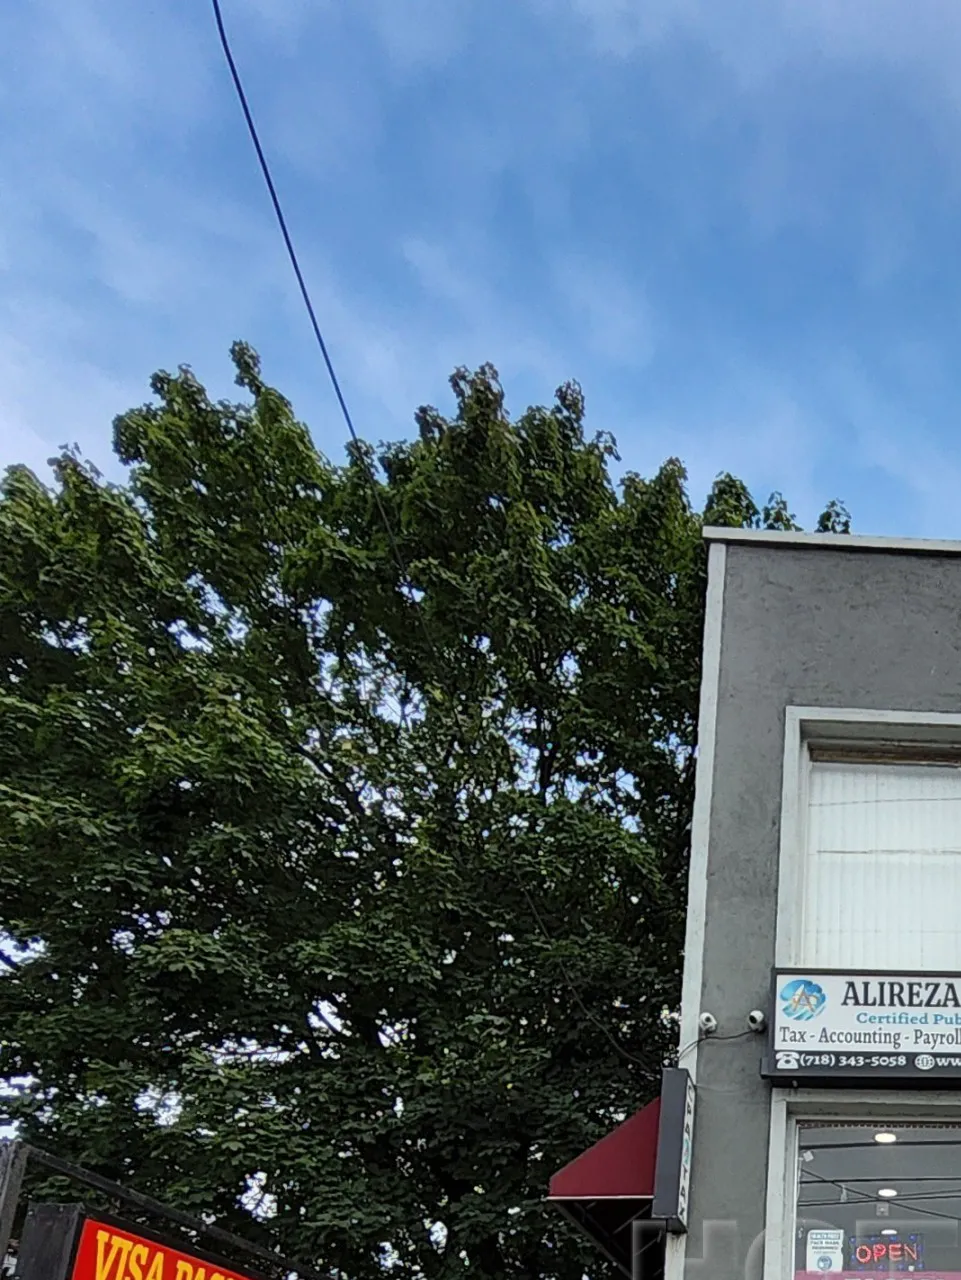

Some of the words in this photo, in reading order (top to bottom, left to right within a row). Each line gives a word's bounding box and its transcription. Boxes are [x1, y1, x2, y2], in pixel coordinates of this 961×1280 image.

[841, 981, 961, 1008] ALIREZA
[856, 1012, 928, 1025] Certified
[779, 1026, 807, 1042] Tax
[818, 1027, 901, 1049] Accounting
[800, 1054, 835, 1067] (718)
[838, 1055, 907, 1068] 343-5058
[856, 1243, 918, 1264] OPEN
